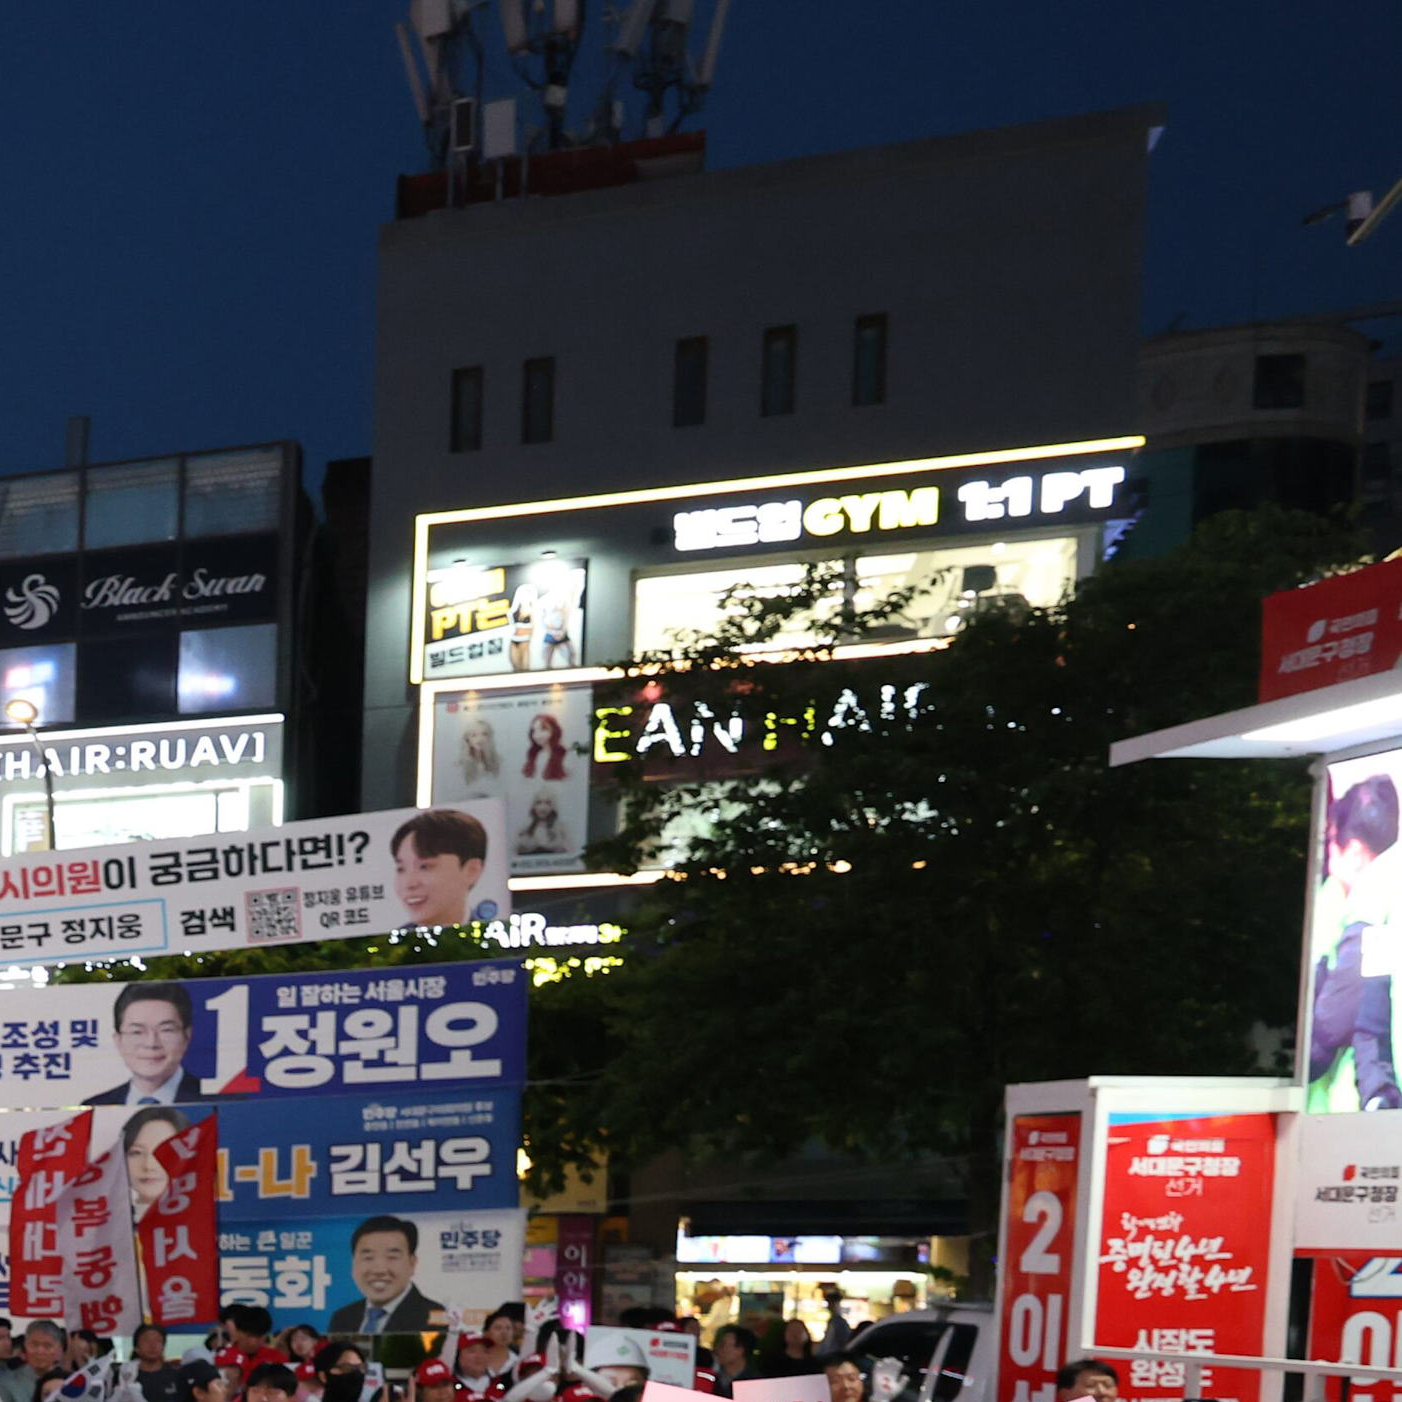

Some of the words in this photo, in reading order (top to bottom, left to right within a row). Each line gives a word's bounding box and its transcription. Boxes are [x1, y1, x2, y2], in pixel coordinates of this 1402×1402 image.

[958, 476, 1033, 522] 1:1
[1041, 466, 1125, 513] PT
[80, 572, 179, 609] Black
[182, 568, 267, 600] Swan
[149, 831, 371, 887] 궁금하다면!?
[302, 887, 342, 909] 정지웅
[345, 884, 385, 905] 유튜브
[61, 913, 142, 943] 정지웅
[180, 906, 235, 936] 검색
[320, 910, 341, 928] QR
[344, 908, 370, 926] 코드
[277, 985, 297, 1007] 일
[301, 983, 361, 1005] 잘하는
[364, 976, 446, 1001] 서울시장
[0, 1020, 61, 1049] 조성
[71, 1018, 100, 1048] 및
[199, 985, 261, 1095] 1
[258, 1001, 502, 1089] 정원오
[11, 1051, 72, 1080] 추진
[329, 1137, 492, 1195] 김선우
[1128, 1157, 1241, 1177] 서대문구청장
[1360, 1166, 1399, 1180] 국민의힘
[1165, 1177, 1204, 1197] 선거
[1314, 1186, 1398, 1203] 서대문구청장
[256, 1230, 277, 1251] 큰
[279, 1231, 314, 1250] 일꾼
[439, 1229, 502, 1249] 민주당
[1020, 1191, 1063, 1274] 2
[1130, 1329, 1216, 1354] 시작도
